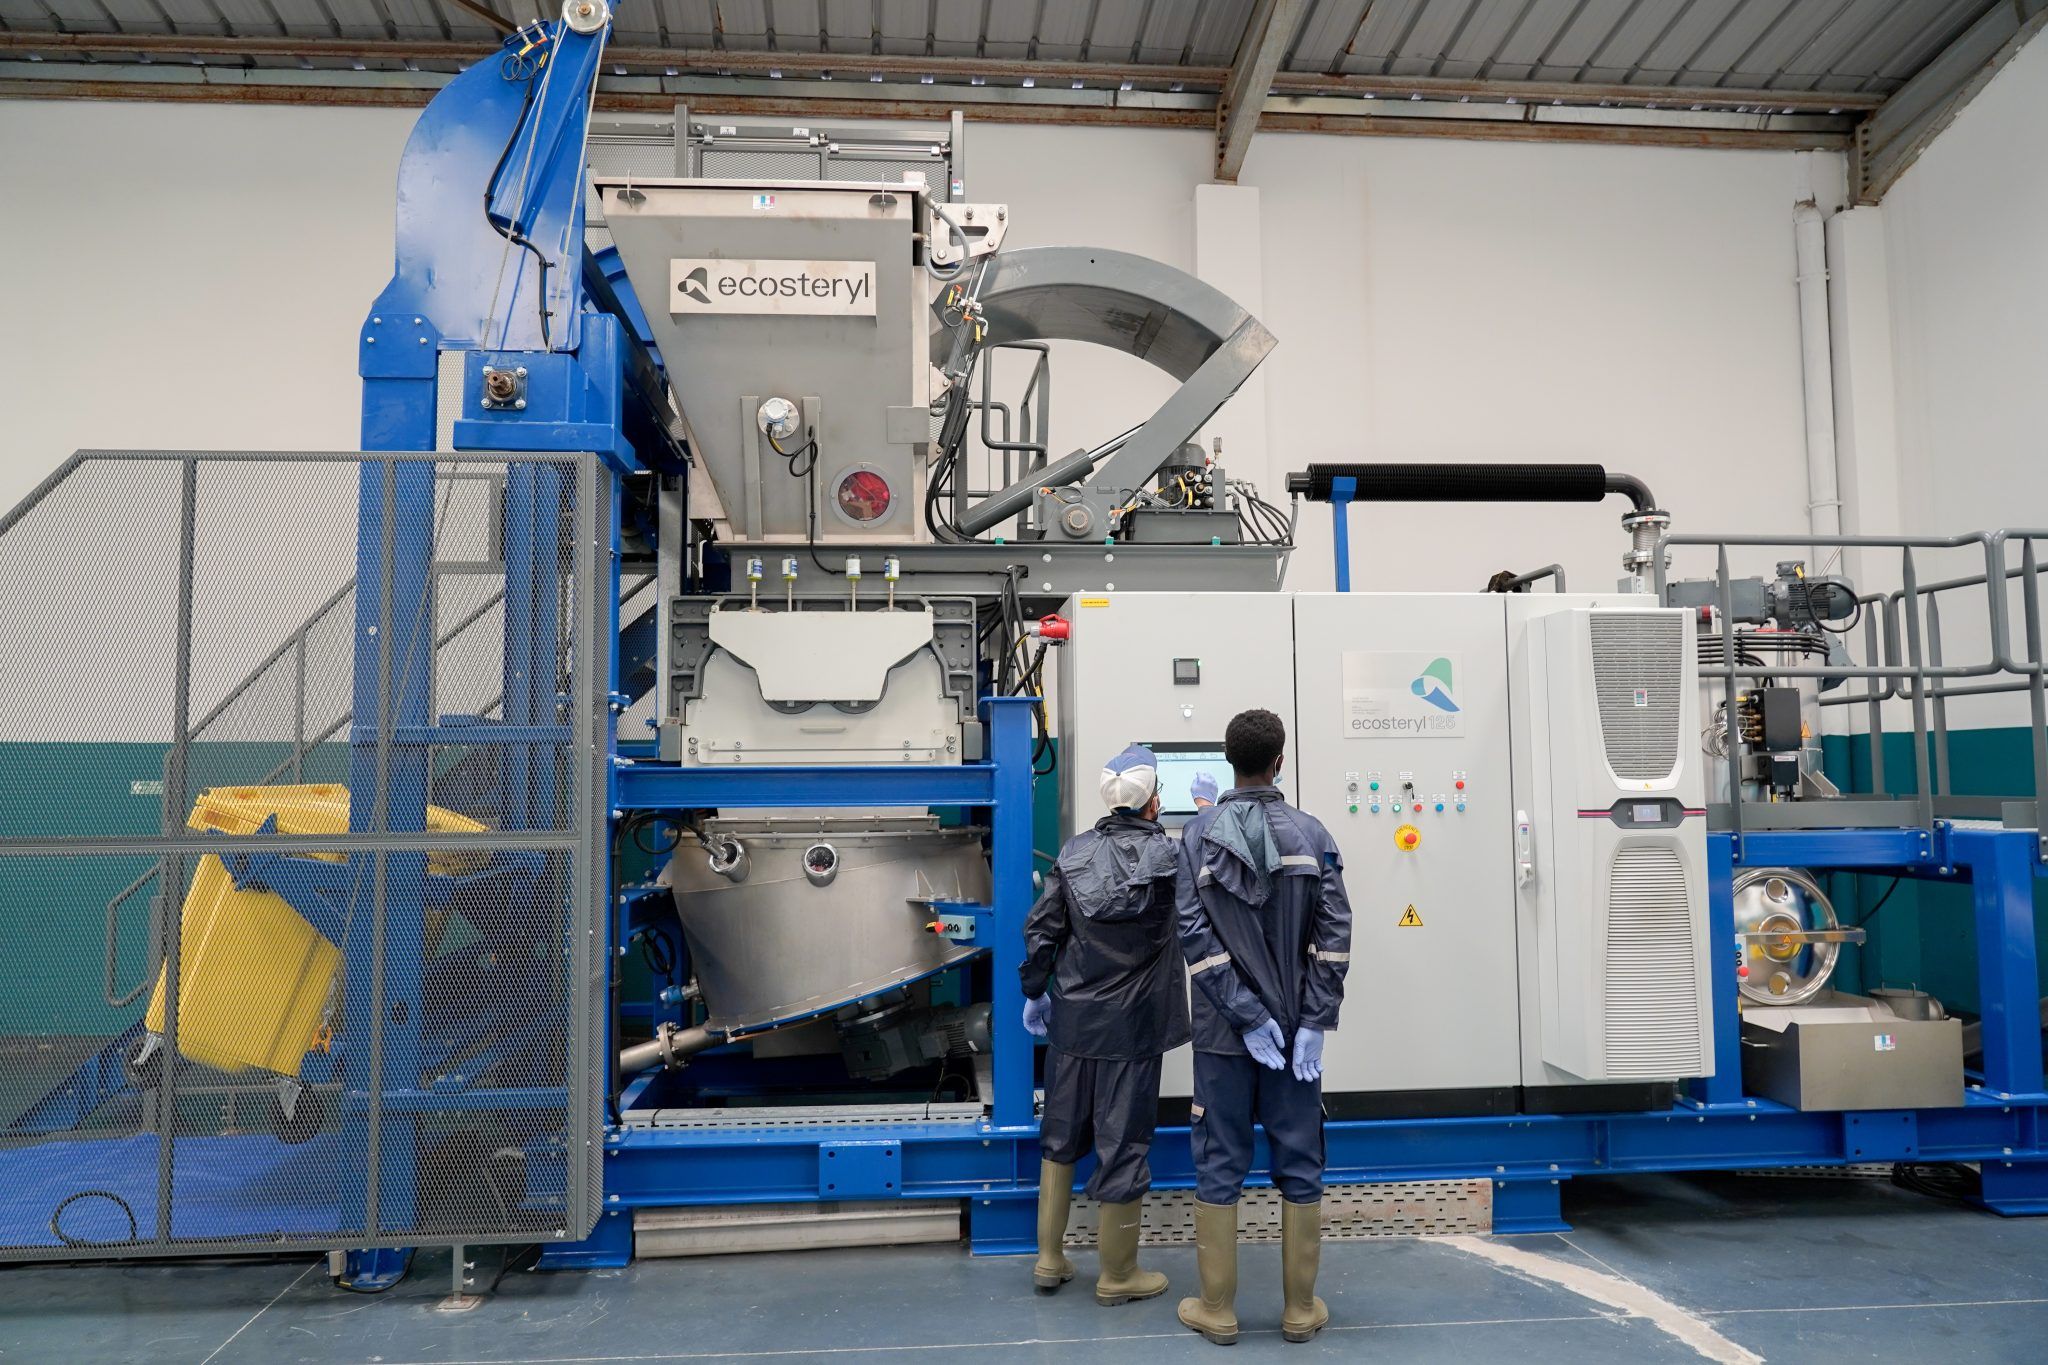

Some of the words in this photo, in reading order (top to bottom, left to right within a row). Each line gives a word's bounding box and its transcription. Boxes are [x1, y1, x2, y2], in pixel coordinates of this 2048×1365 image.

[718, 273, 869, 304] ecosteryl
[1352, 716, 1426, 733] ecosteryl
[1429, 715, 1456, 730] 125
